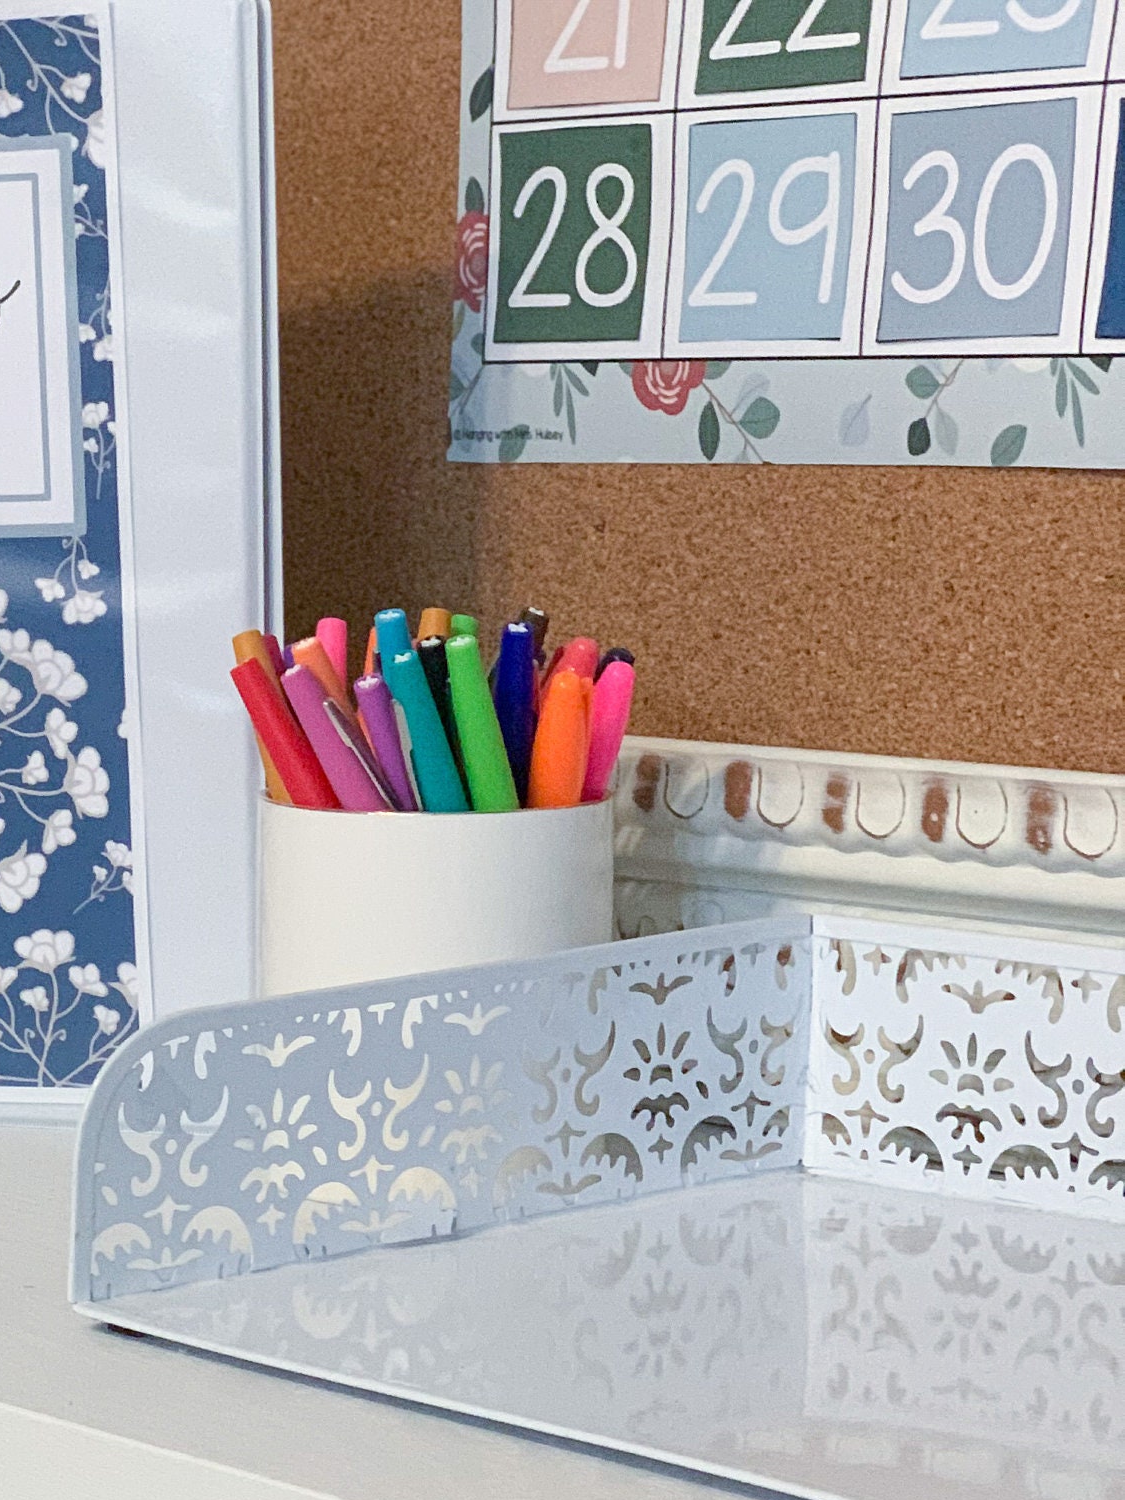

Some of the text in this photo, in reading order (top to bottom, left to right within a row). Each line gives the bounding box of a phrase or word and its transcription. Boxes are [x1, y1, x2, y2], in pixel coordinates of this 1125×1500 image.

[507, 162, 639, 308] 28
[687, 151, 842, 305] 29
[890, 143, 1059, 304] 30
